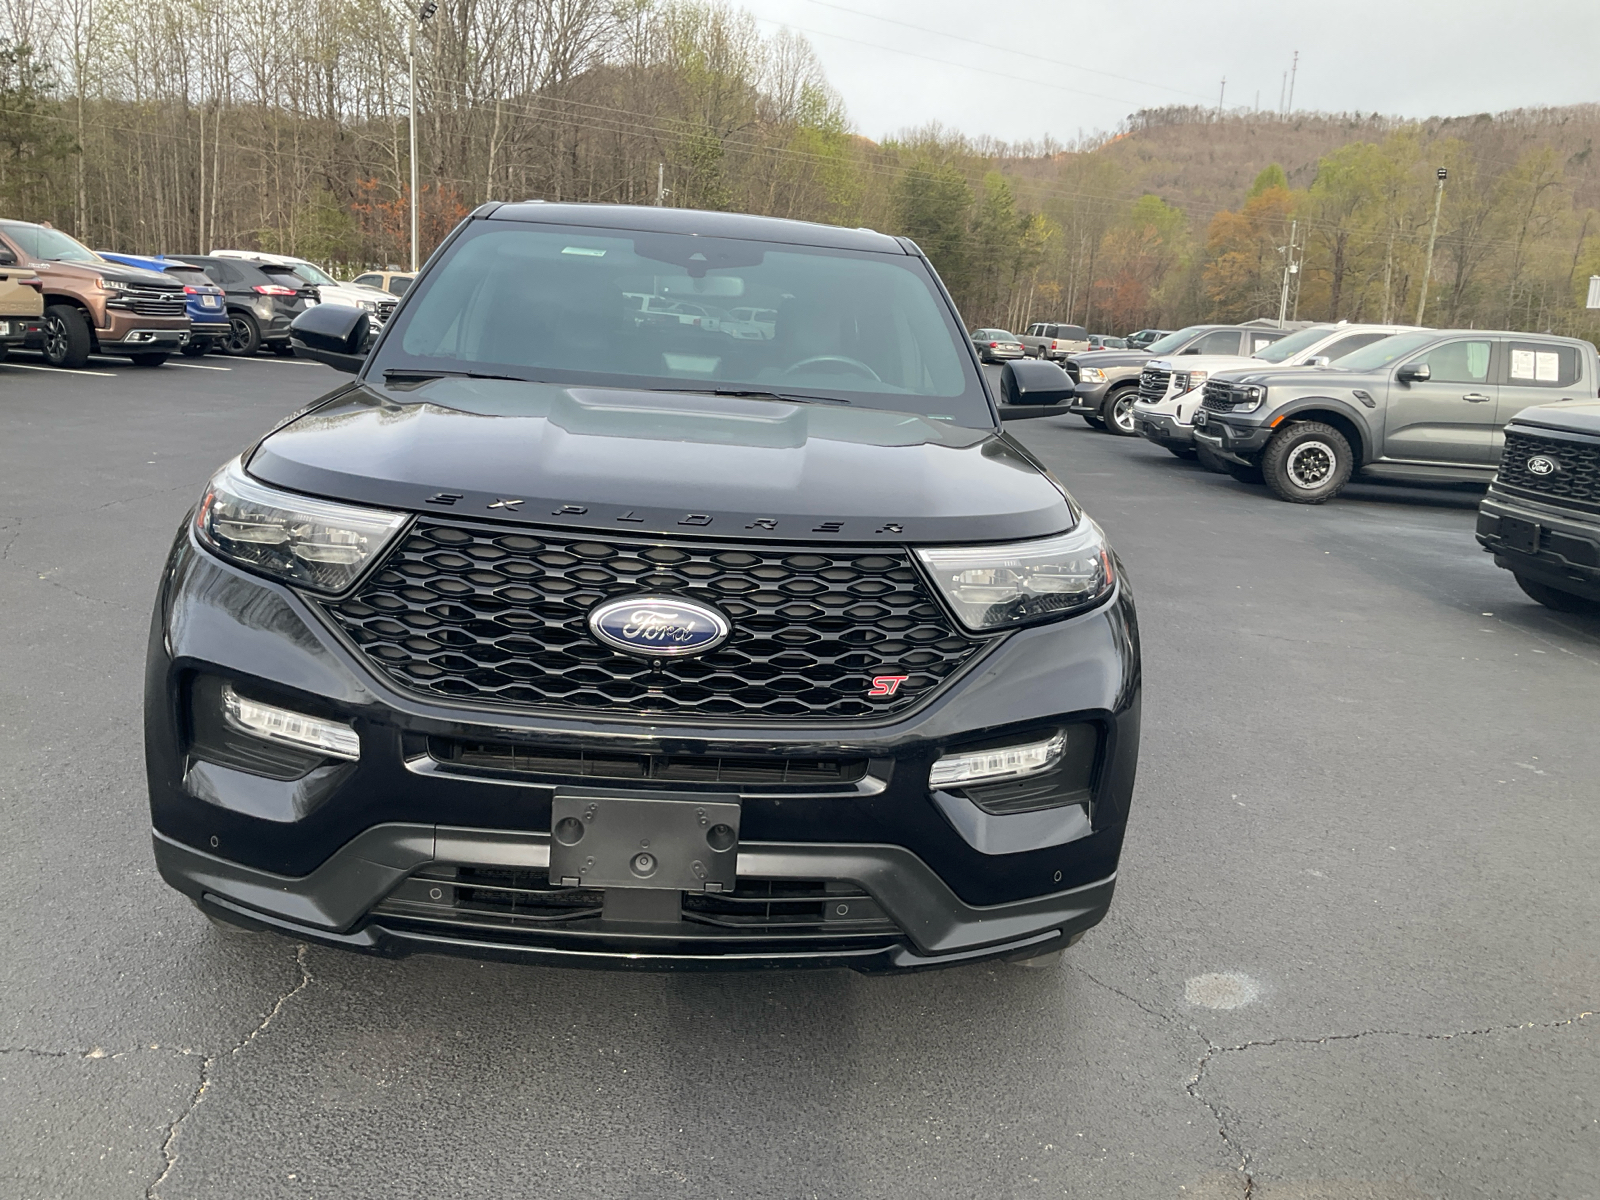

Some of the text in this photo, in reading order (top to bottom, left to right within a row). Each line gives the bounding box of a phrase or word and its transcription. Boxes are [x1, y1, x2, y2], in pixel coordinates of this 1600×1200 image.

[425, 492, 904, 534] EXPLORER
[622, 609, 696, 642] Ford
[868, 675, 909, 696] ST
